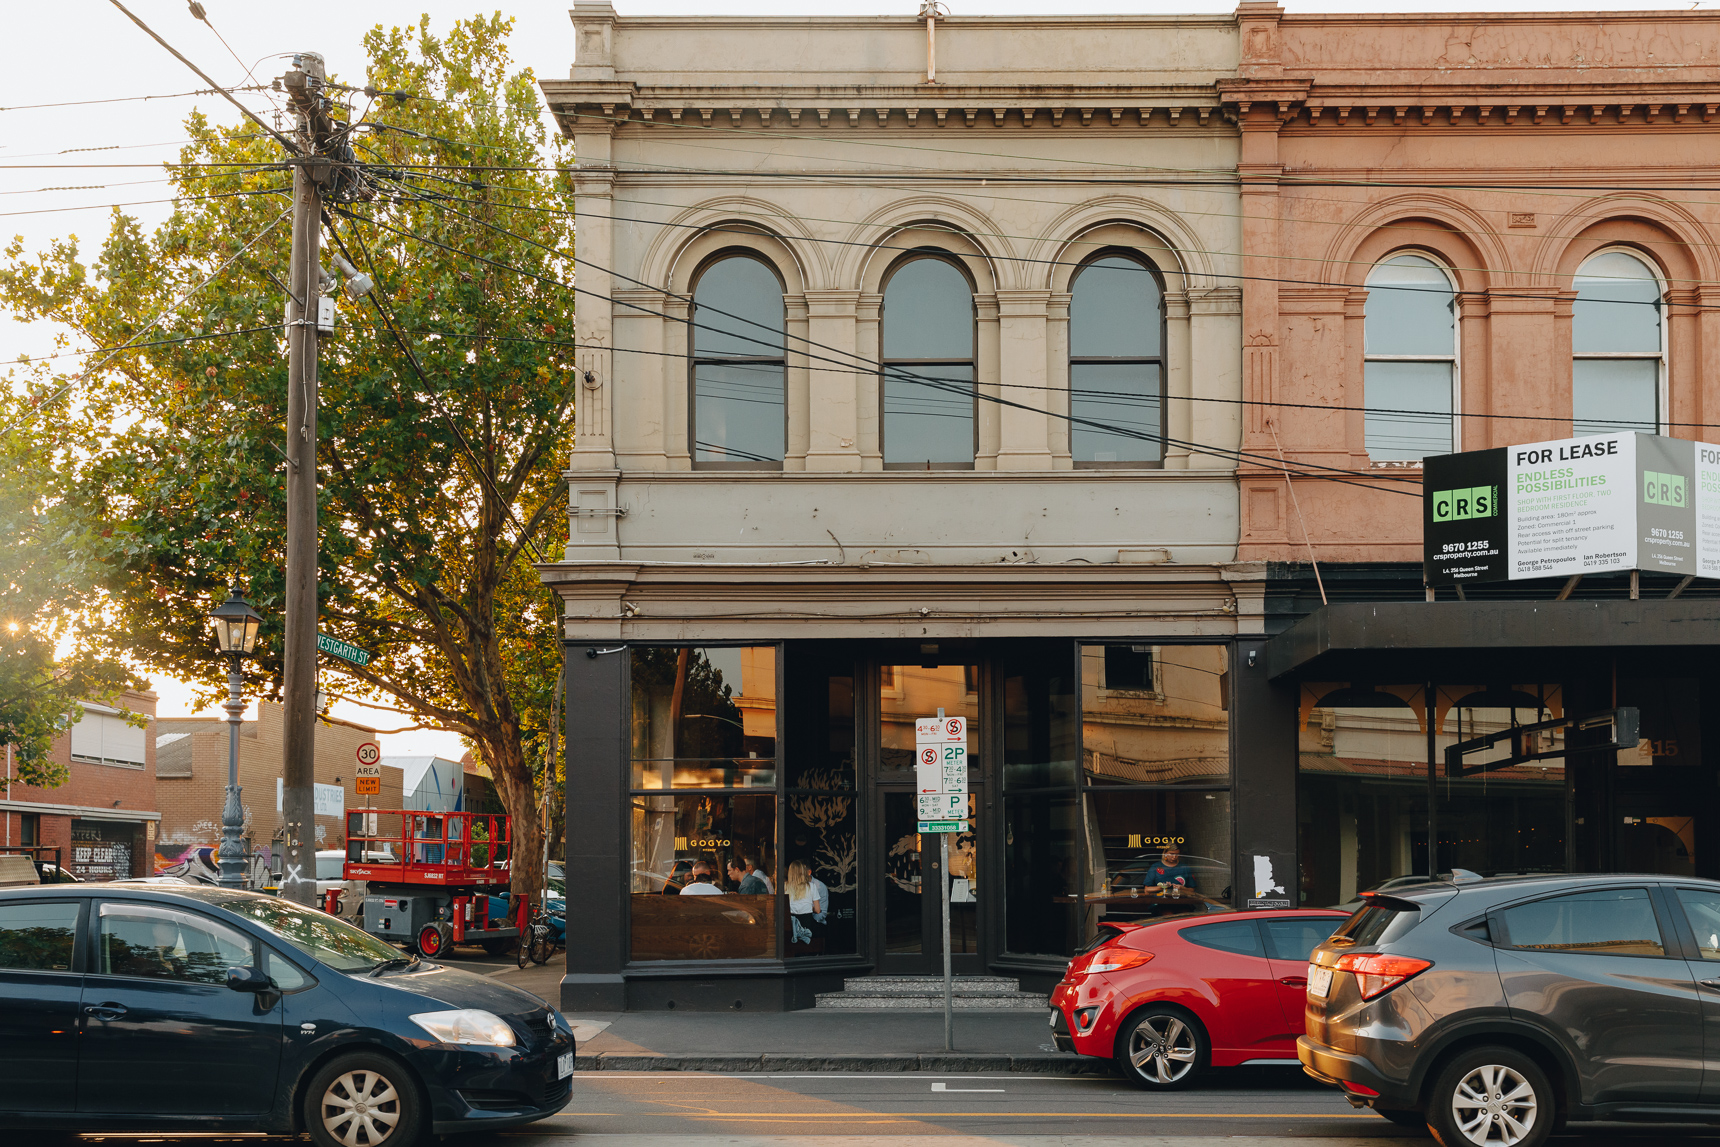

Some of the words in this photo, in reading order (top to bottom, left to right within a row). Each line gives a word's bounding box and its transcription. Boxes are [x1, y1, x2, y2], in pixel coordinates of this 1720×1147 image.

[1517, 449, 1552, 466] FOR
[1560, 440, 1618, 461] LEASE
[1517, 467, 1574, 483] ENDLESS
[1517, 475, 1606, 494] POSSIBILITIES
[1553, 494, 1571, 502] FIRST
[1647, 481, 1682, 503] CRS
[1437, 496, 1488, 517] CRS
[1517, 503, 1550, 513] BEDROOM
[1551, 500, 1588, 509] RESIDENCE
[1538, 520, 1570, 528] Commercial
[1651, 528, 1667, 537] 9670
[1668, 530, 1683, 539] 1255
[1442, 543, 1465, 552] 9670
[1467, 540, 1489, 550] 1255
[1433, 549, 1499, 560] crsproperty.com.au
[1540, 556, 1576, 564] Petropoulos
[358, 651, 368, 664] ST
[361, 749, 376, 759] 30
[944, 747, 965, 760] 2P
[1639, 740, 1679, 756] 415
[315, 787, 343, 803] DUSTRIES
[950, 796, 960, 808] P
[690, 839, 731, 847] GOGYO
[1144, 836, 1185, 844] GOGYO
[76, 847, 92, 863] KEEP
[93, 847, 113, 863] CLEAR
[76, 866, 86, 874] 24
[88, 866, 113, 874] HOURS
